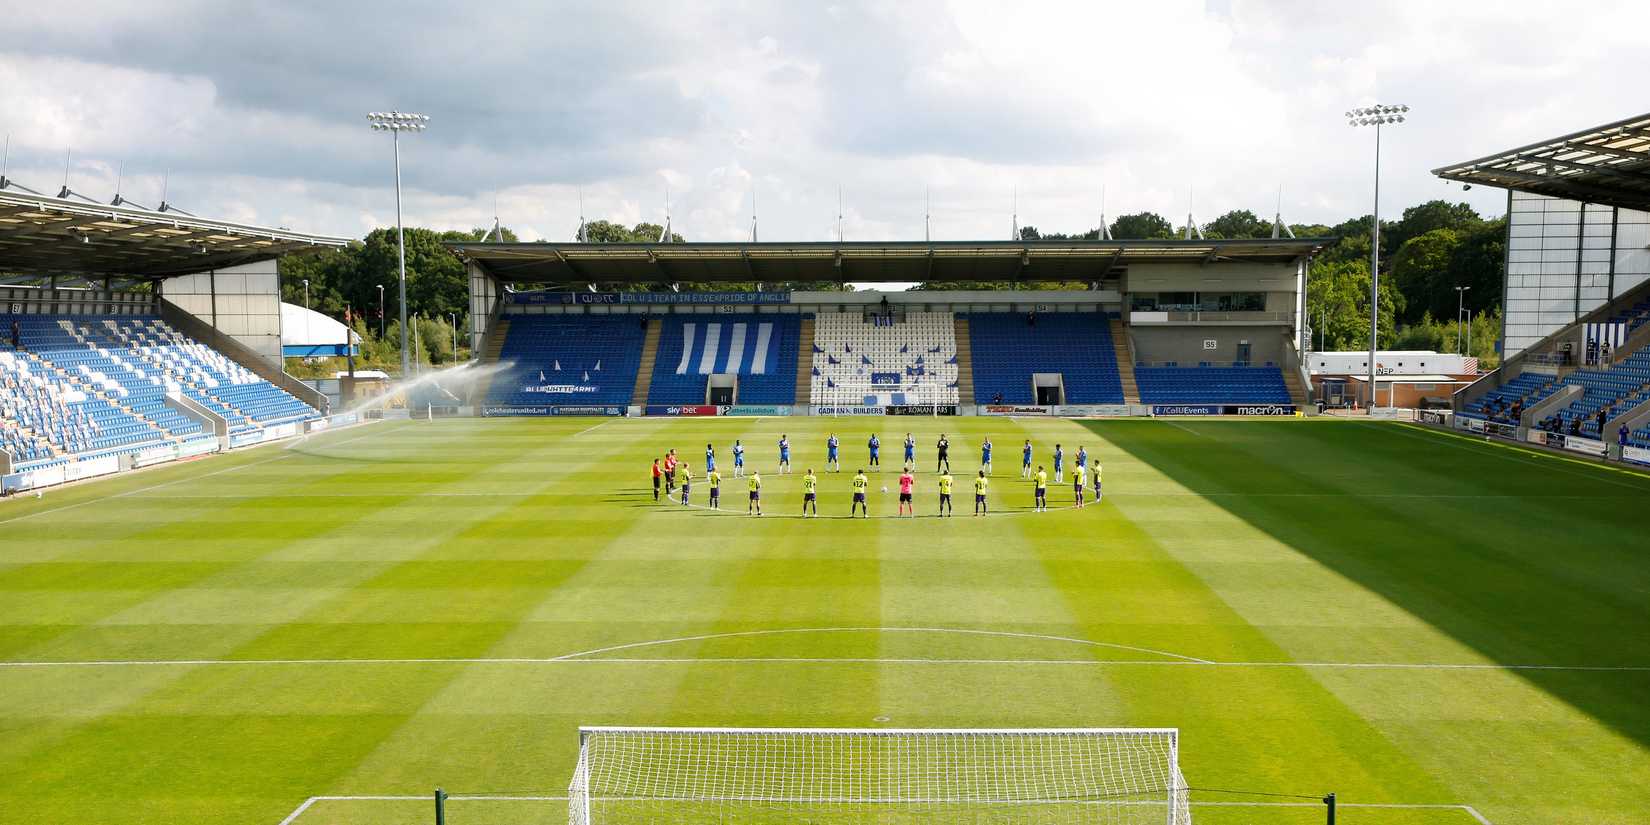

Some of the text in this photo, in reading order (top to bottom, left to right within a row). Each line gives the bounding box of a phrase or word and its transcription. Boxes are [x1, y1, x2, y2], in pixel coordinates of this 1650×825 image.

[655, 294, 677, 302] TEAM
[666, 406, 697, 415] sky bet
[853, 407, 883, 415] BUILDERS
[1238, 405, 1284, 415] macron
